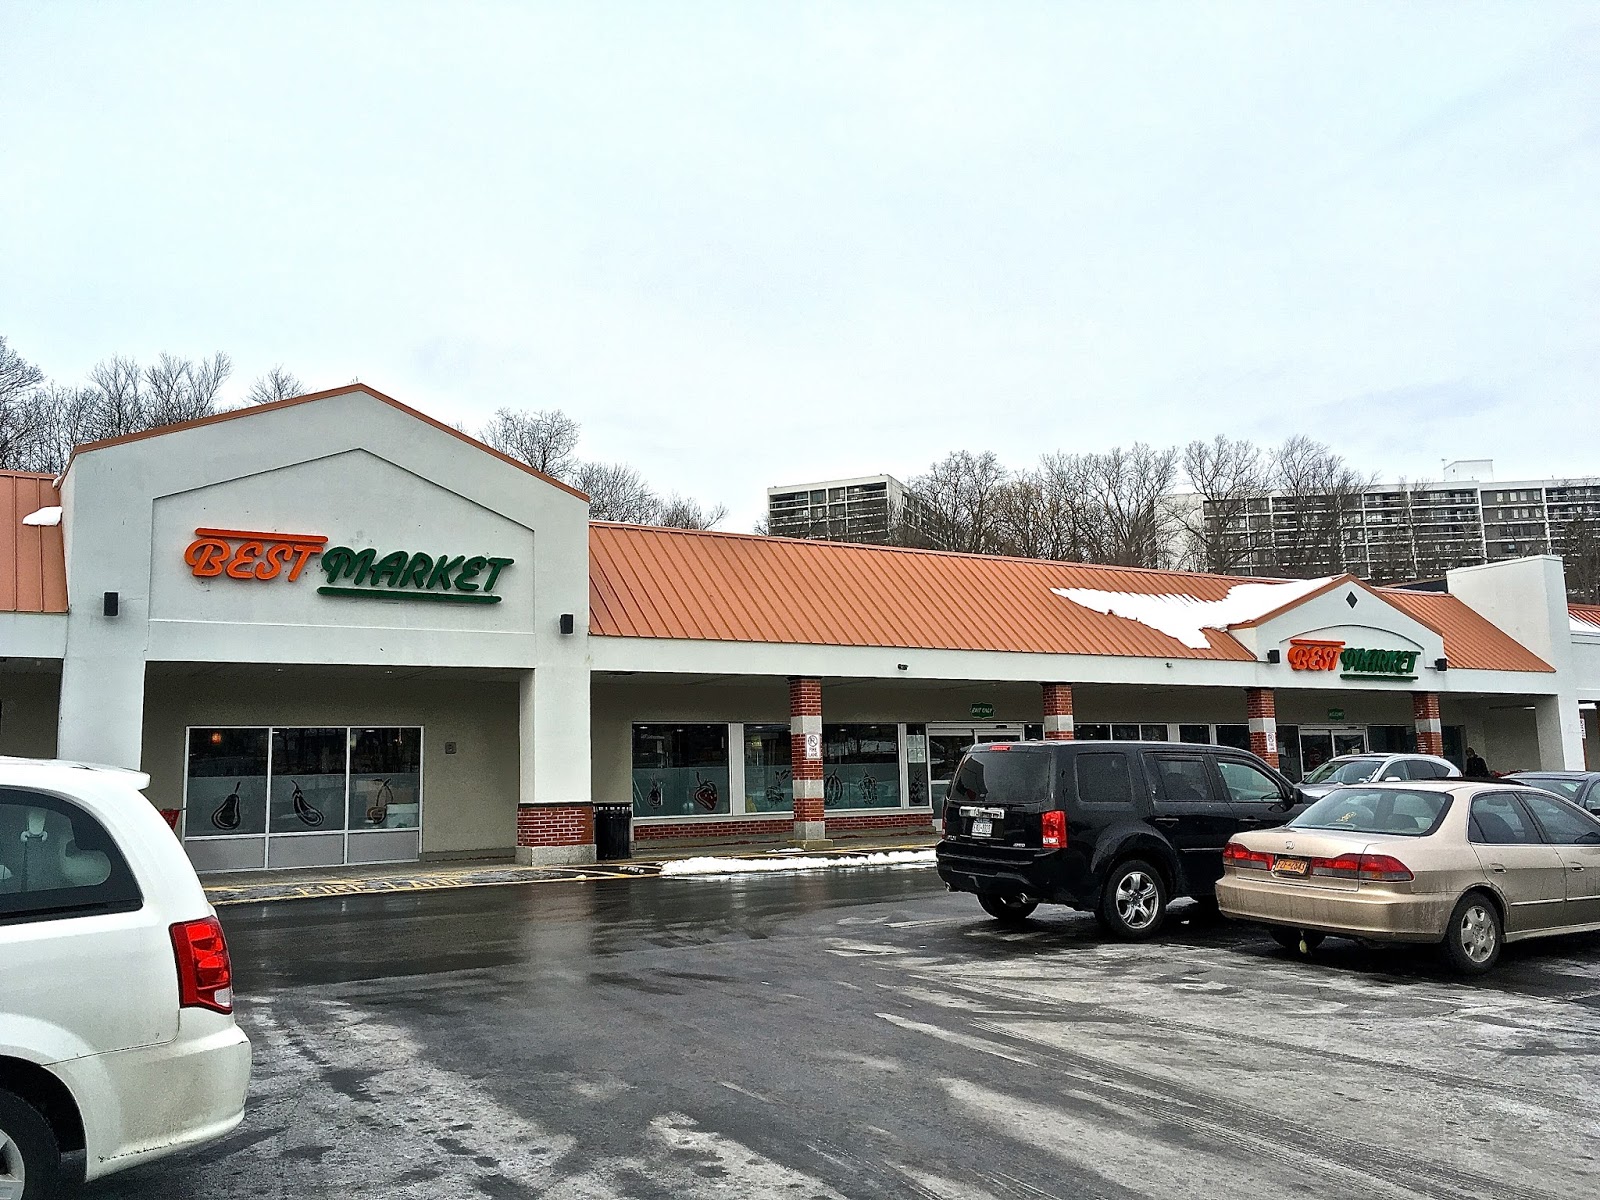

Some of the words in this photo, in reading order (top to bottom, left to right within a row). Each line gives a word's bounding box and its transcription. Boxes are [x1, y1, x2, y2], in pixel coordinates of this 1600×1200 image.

[184, 537, 325, 583] BEST
[320, 546, 515, 592] MARKET
[1288, 645, 1344, 671] BEST
[1340, 648, 1422, 674] MARKET
[294, 883, 375, 896] FIRE
[381, 878, 472, 889] LANE
